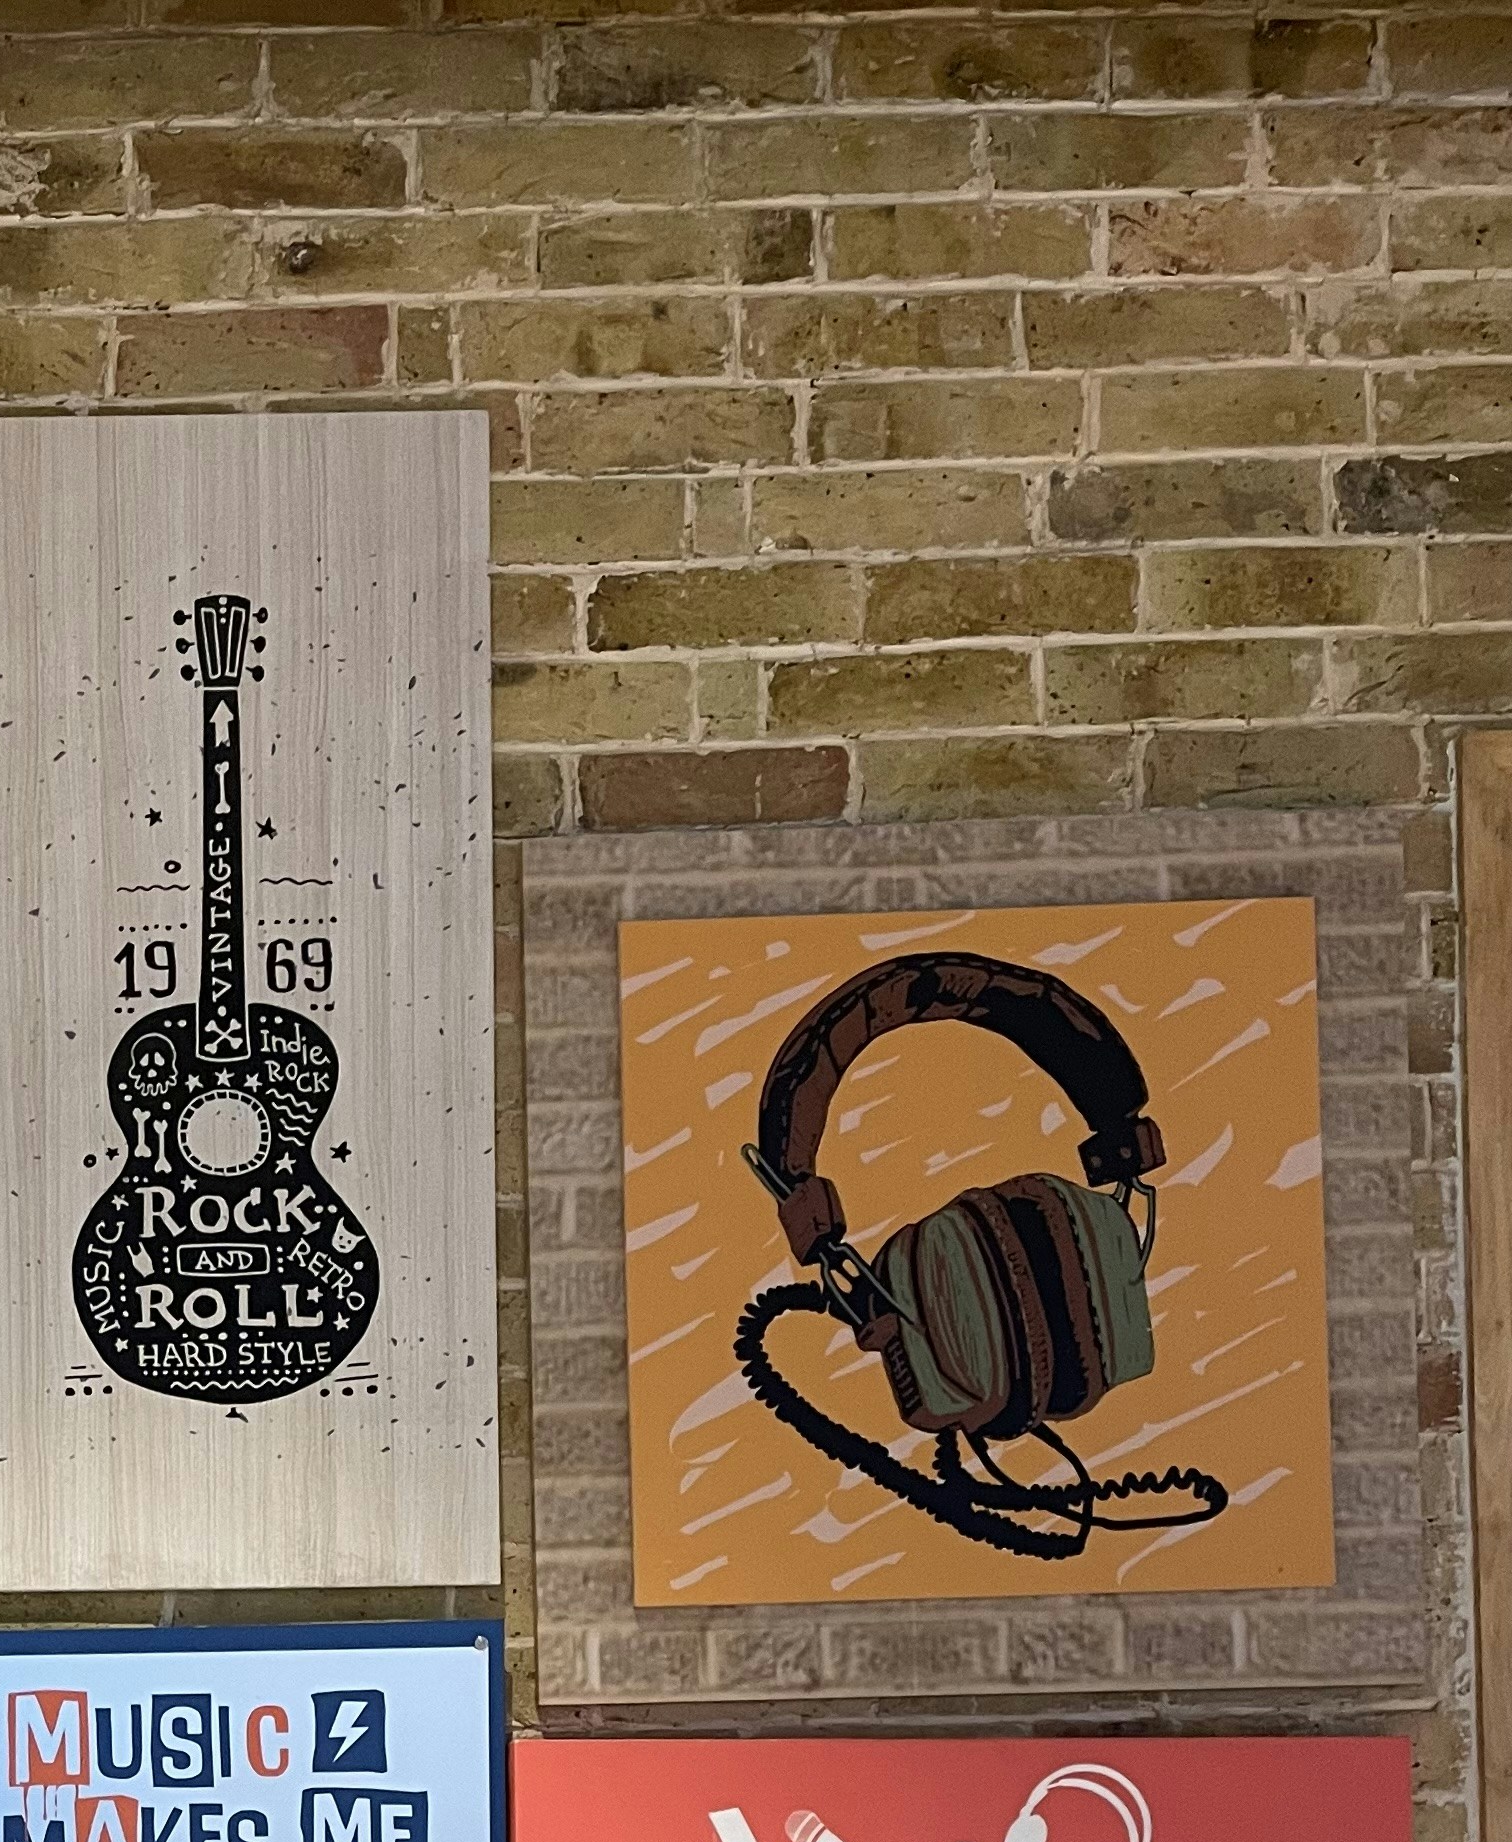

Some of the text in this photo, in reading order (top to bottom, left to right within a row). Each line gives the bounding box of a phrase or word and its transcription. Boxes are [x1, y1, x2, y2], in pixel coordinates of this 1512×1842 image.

[208, 836, 232, 1003] VINTAGE
[113, 937, 334, 998] 19 69
[260, 1022, 331, 1066] Indie
[264, 1060, 331, 1093] ROCK
[134, 1184, 324, 1238] ROCK
[84, 1219, 125, 1334] MUSIC
[193, 1250, 254, 1271] AND
[287, 1237, 365, 1312] RETRO
[134, 1283, 324, 1331] ROLL
[137, 1341, 332, 1368] HARD STYLE
[9, 1690, 290, 1787] MUSIC
